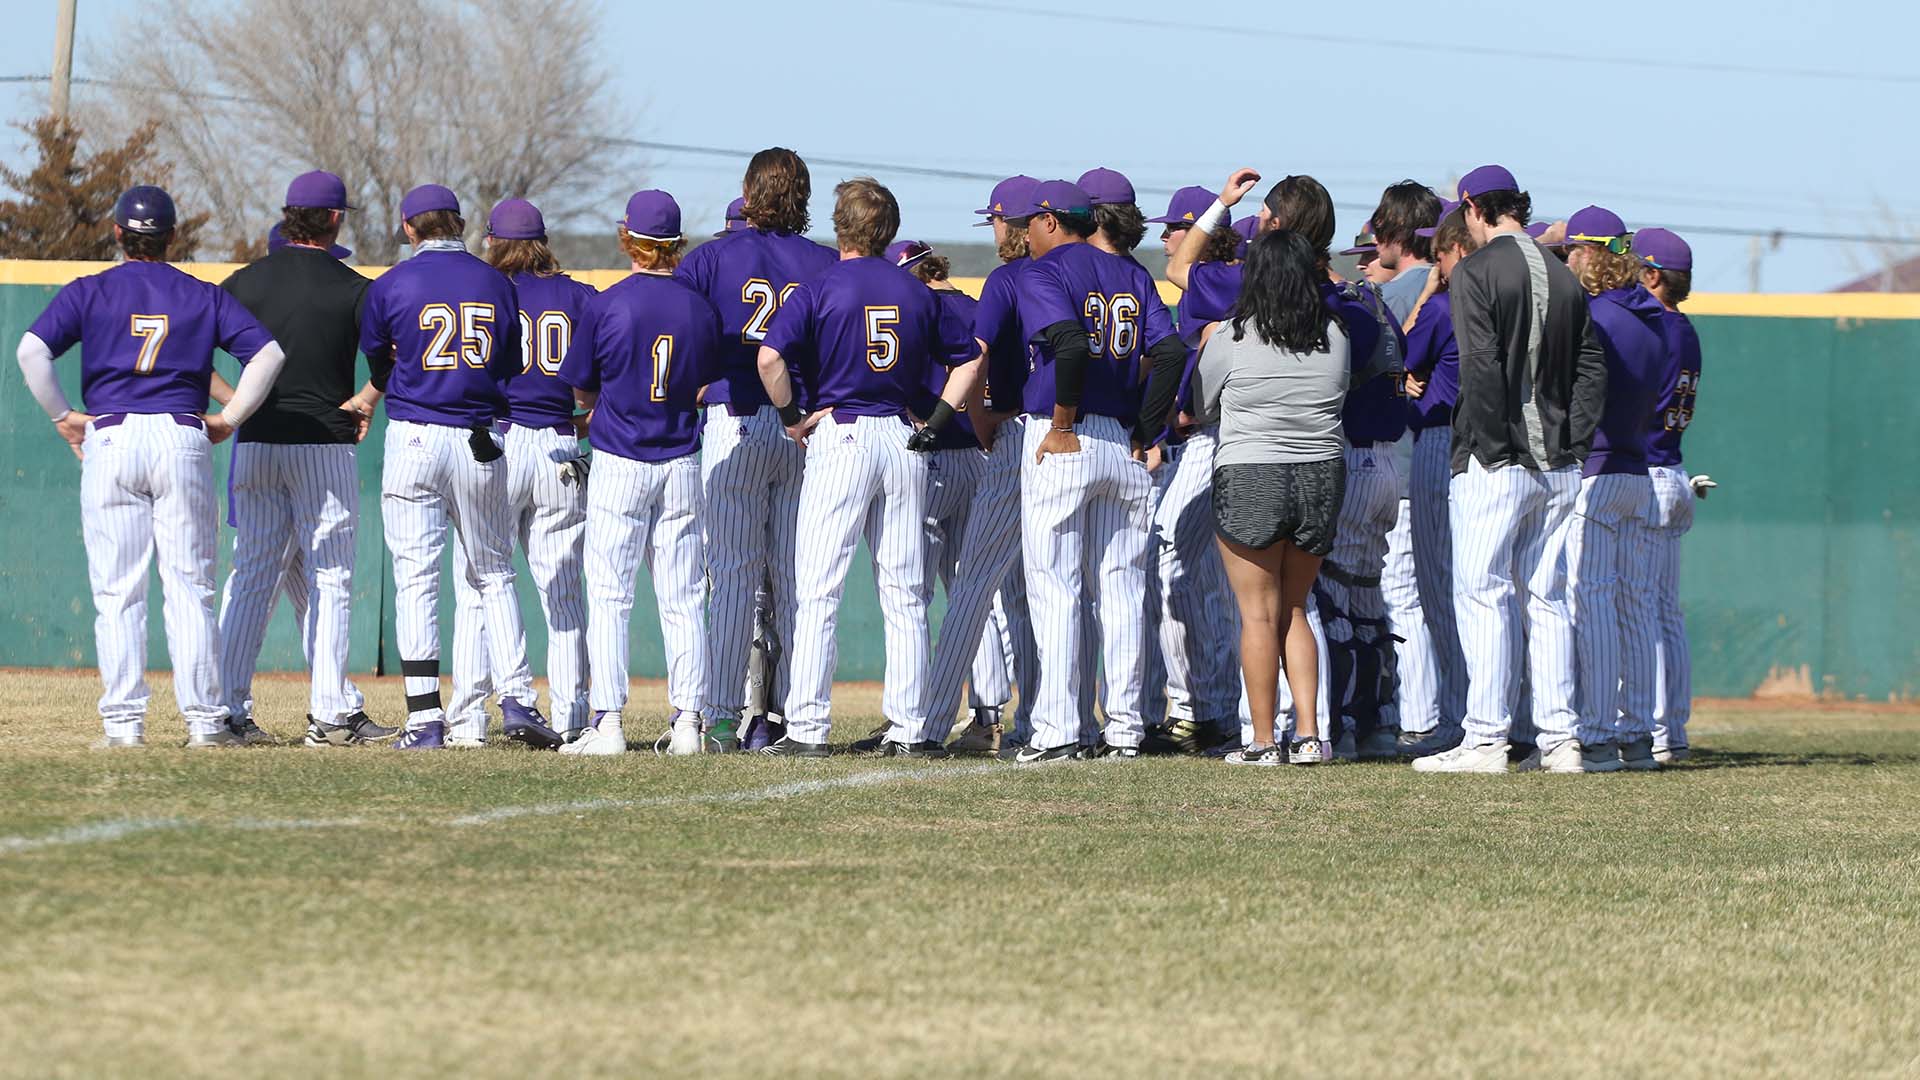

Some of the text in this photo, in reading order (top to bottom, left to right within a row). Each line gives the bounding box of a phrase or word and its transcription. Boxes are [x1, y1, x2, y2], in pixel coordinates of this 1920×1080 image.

[131, 314, 169, 374] 7
[419, 302, 495, 371] 25
[742, 278, 800, 344] 2
[864, 305, 899, 372] 5
[1084, 292, 1140, 360] 36
[650, 334, 673, 402] 1
